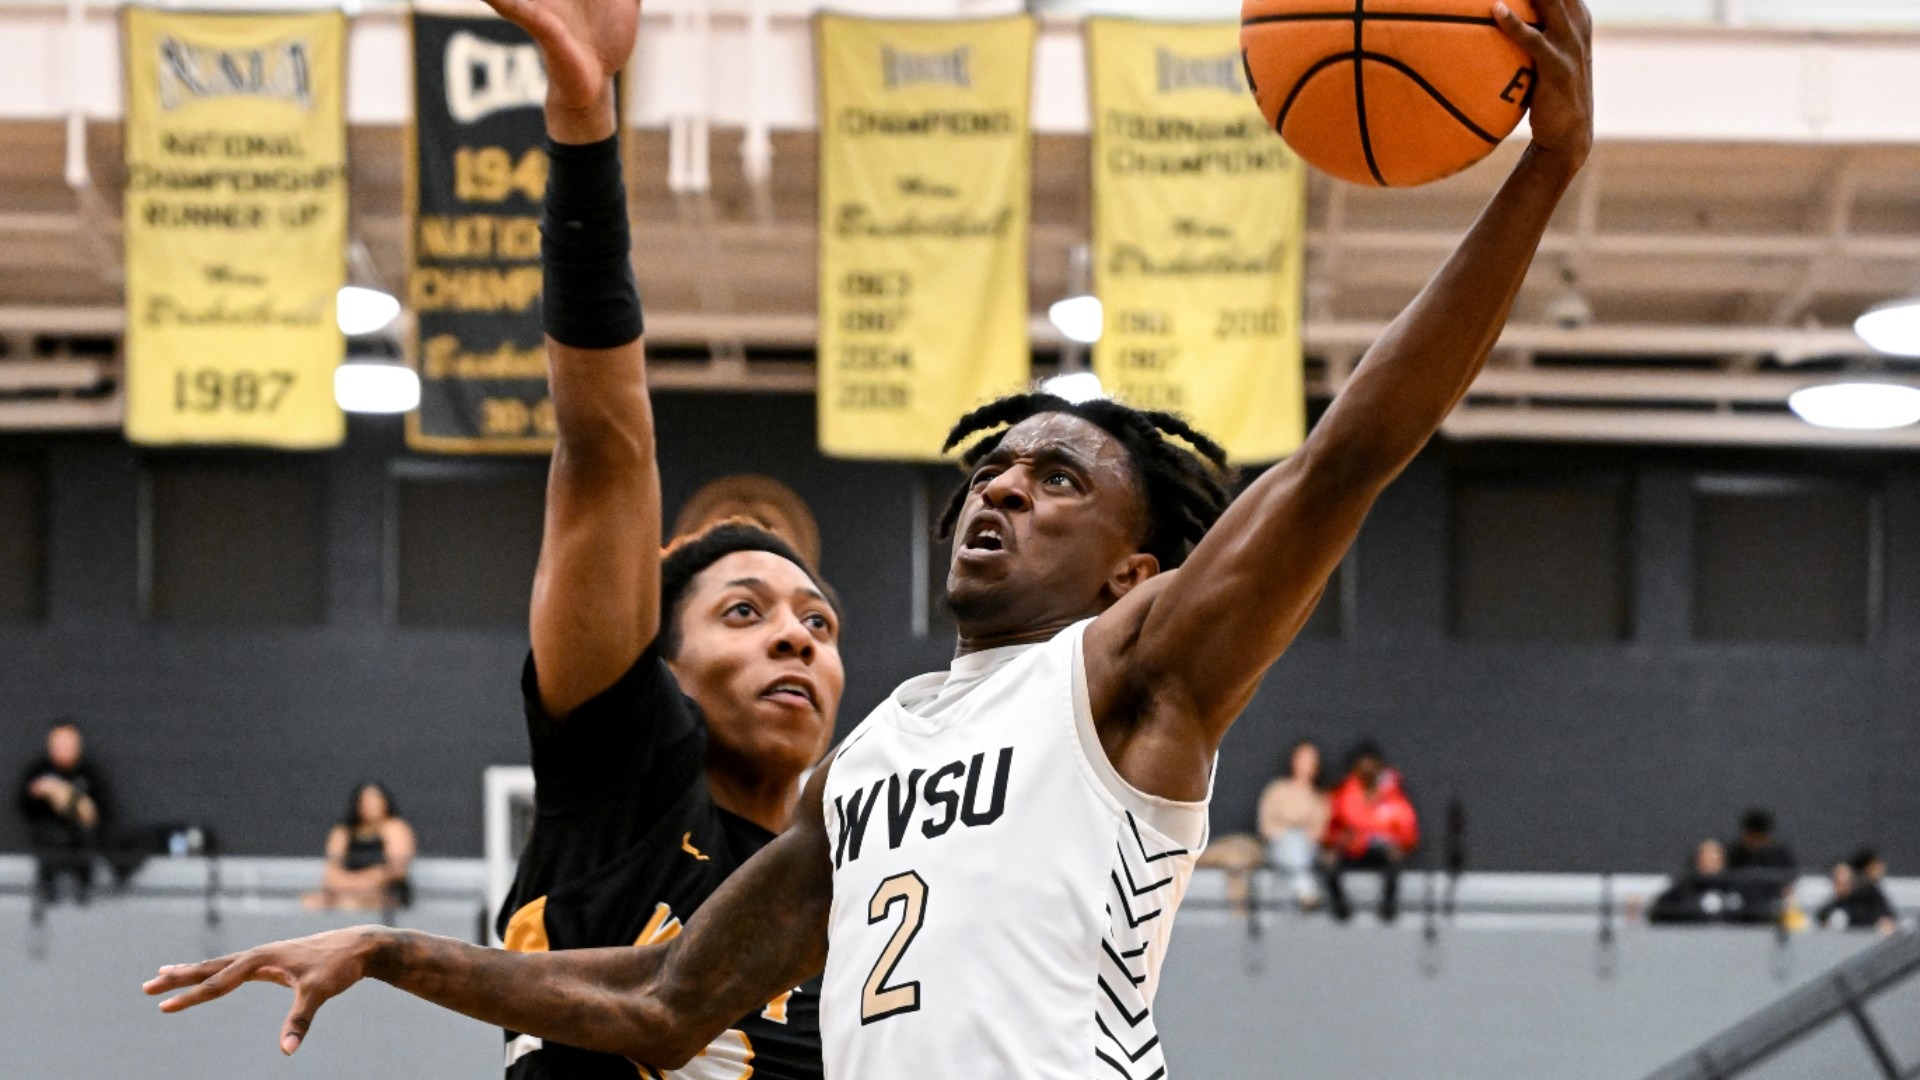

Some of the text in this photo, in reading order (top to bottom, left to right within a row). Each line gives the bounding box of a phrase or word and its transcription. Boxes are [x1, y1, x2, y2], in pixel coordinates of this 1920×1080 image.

[162, 130, 305, 158] NATIONAL
[839, 107, 1014, 136] CHAMPIONS
[1107, 110, 1272, 140] TOURNAMEN
[454, 144, 549, 202] 194
[142, 201, 325, 229] RUNNER UP
[422, 215, 542, 259] NATIO
[410, 266, 543, 313] CHAMP
[173, 367, 297, 415] 1987
[834, 746, 1014, 871] WVSU
[861, 869, 929, 1026] 2
